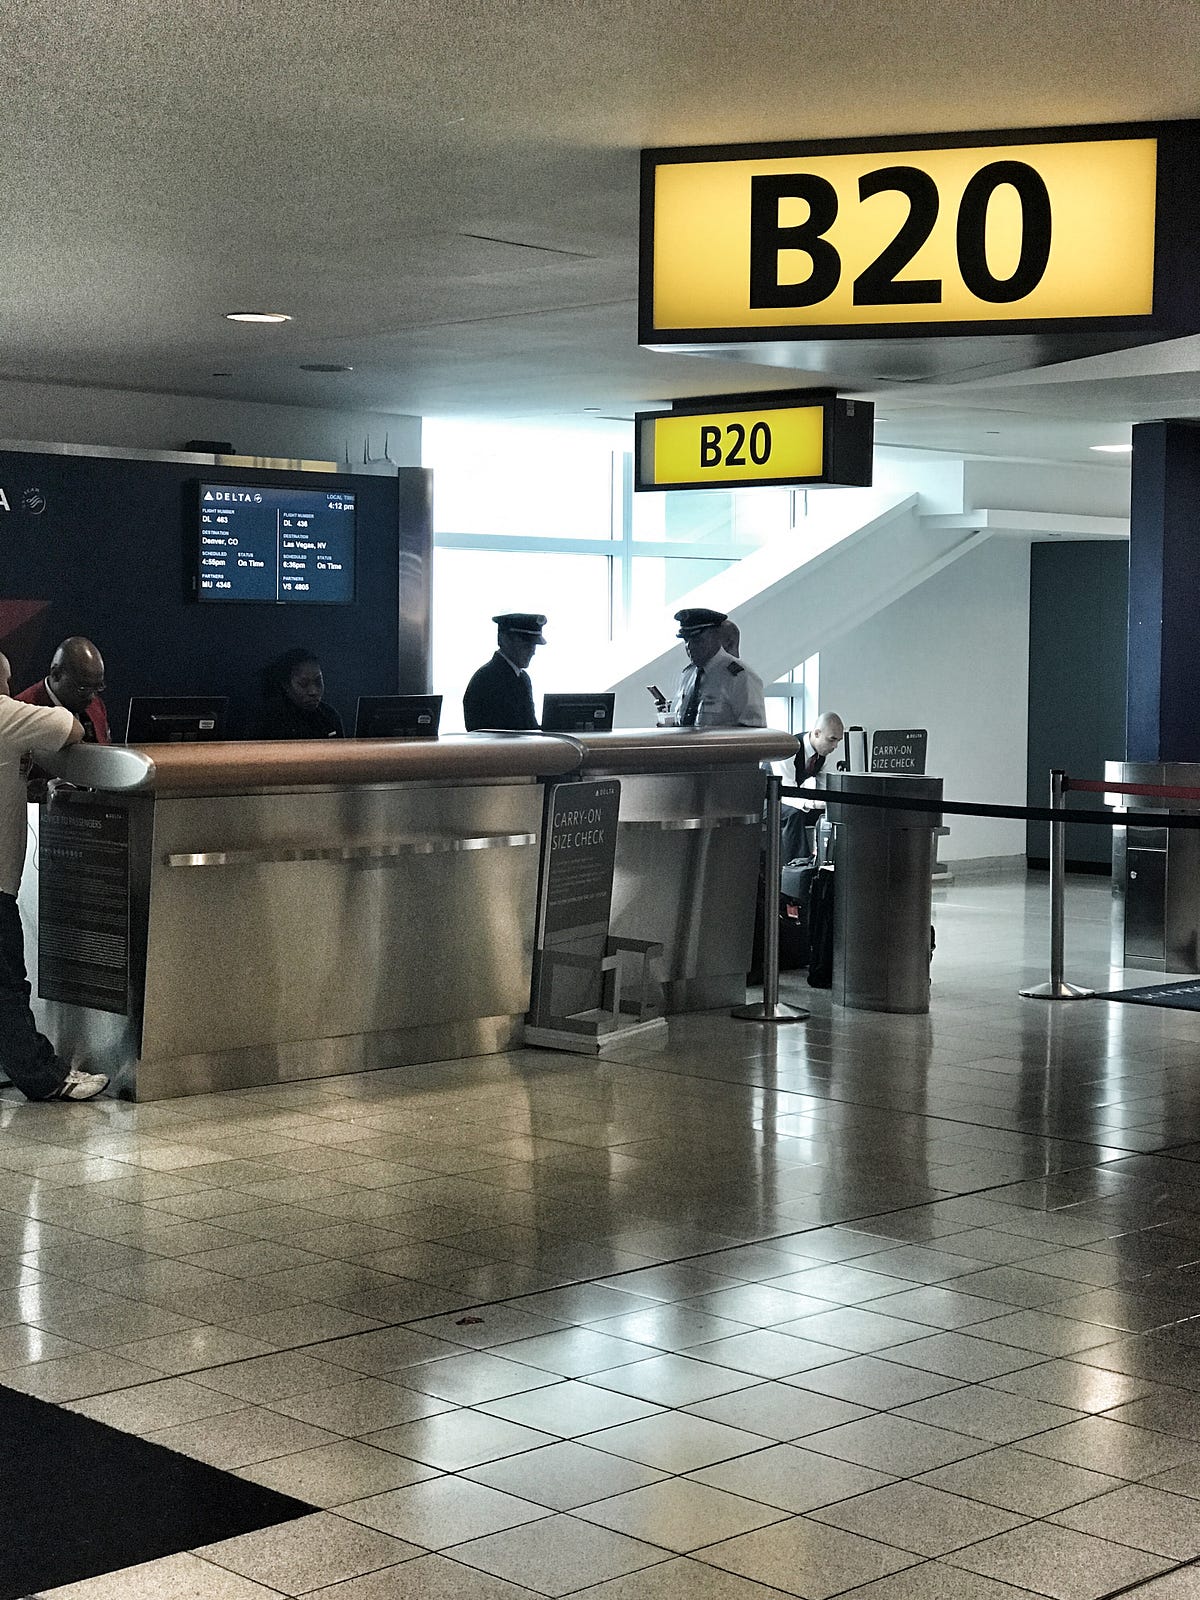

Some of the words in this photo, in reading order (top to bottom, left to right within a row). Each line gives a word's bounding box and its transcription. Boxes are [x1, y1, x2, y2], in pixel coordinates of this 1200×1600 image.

[750, 160, 1052, 310] B20
[700, 421, 773, 468] B20
[216, 492, 252, 502] DELTA
[328, 502, 342, 510] 4:12
[202, 536, 226, 546] Denver,
[228, 538, 238, 546] CO
[296, 542, 316, 550] Vegas,
[248, 560, 264, 568] Time
[873, 745, 912, 756] CARRY-ON
[872, 759, 888, 769] SIZE
[890, 758, 916, 768] CHECK
[554, 808, 602, 828] CARRY-ON
[552, 833, 572, 850] SIZE
[574, 829, 604, 847] CHECK
